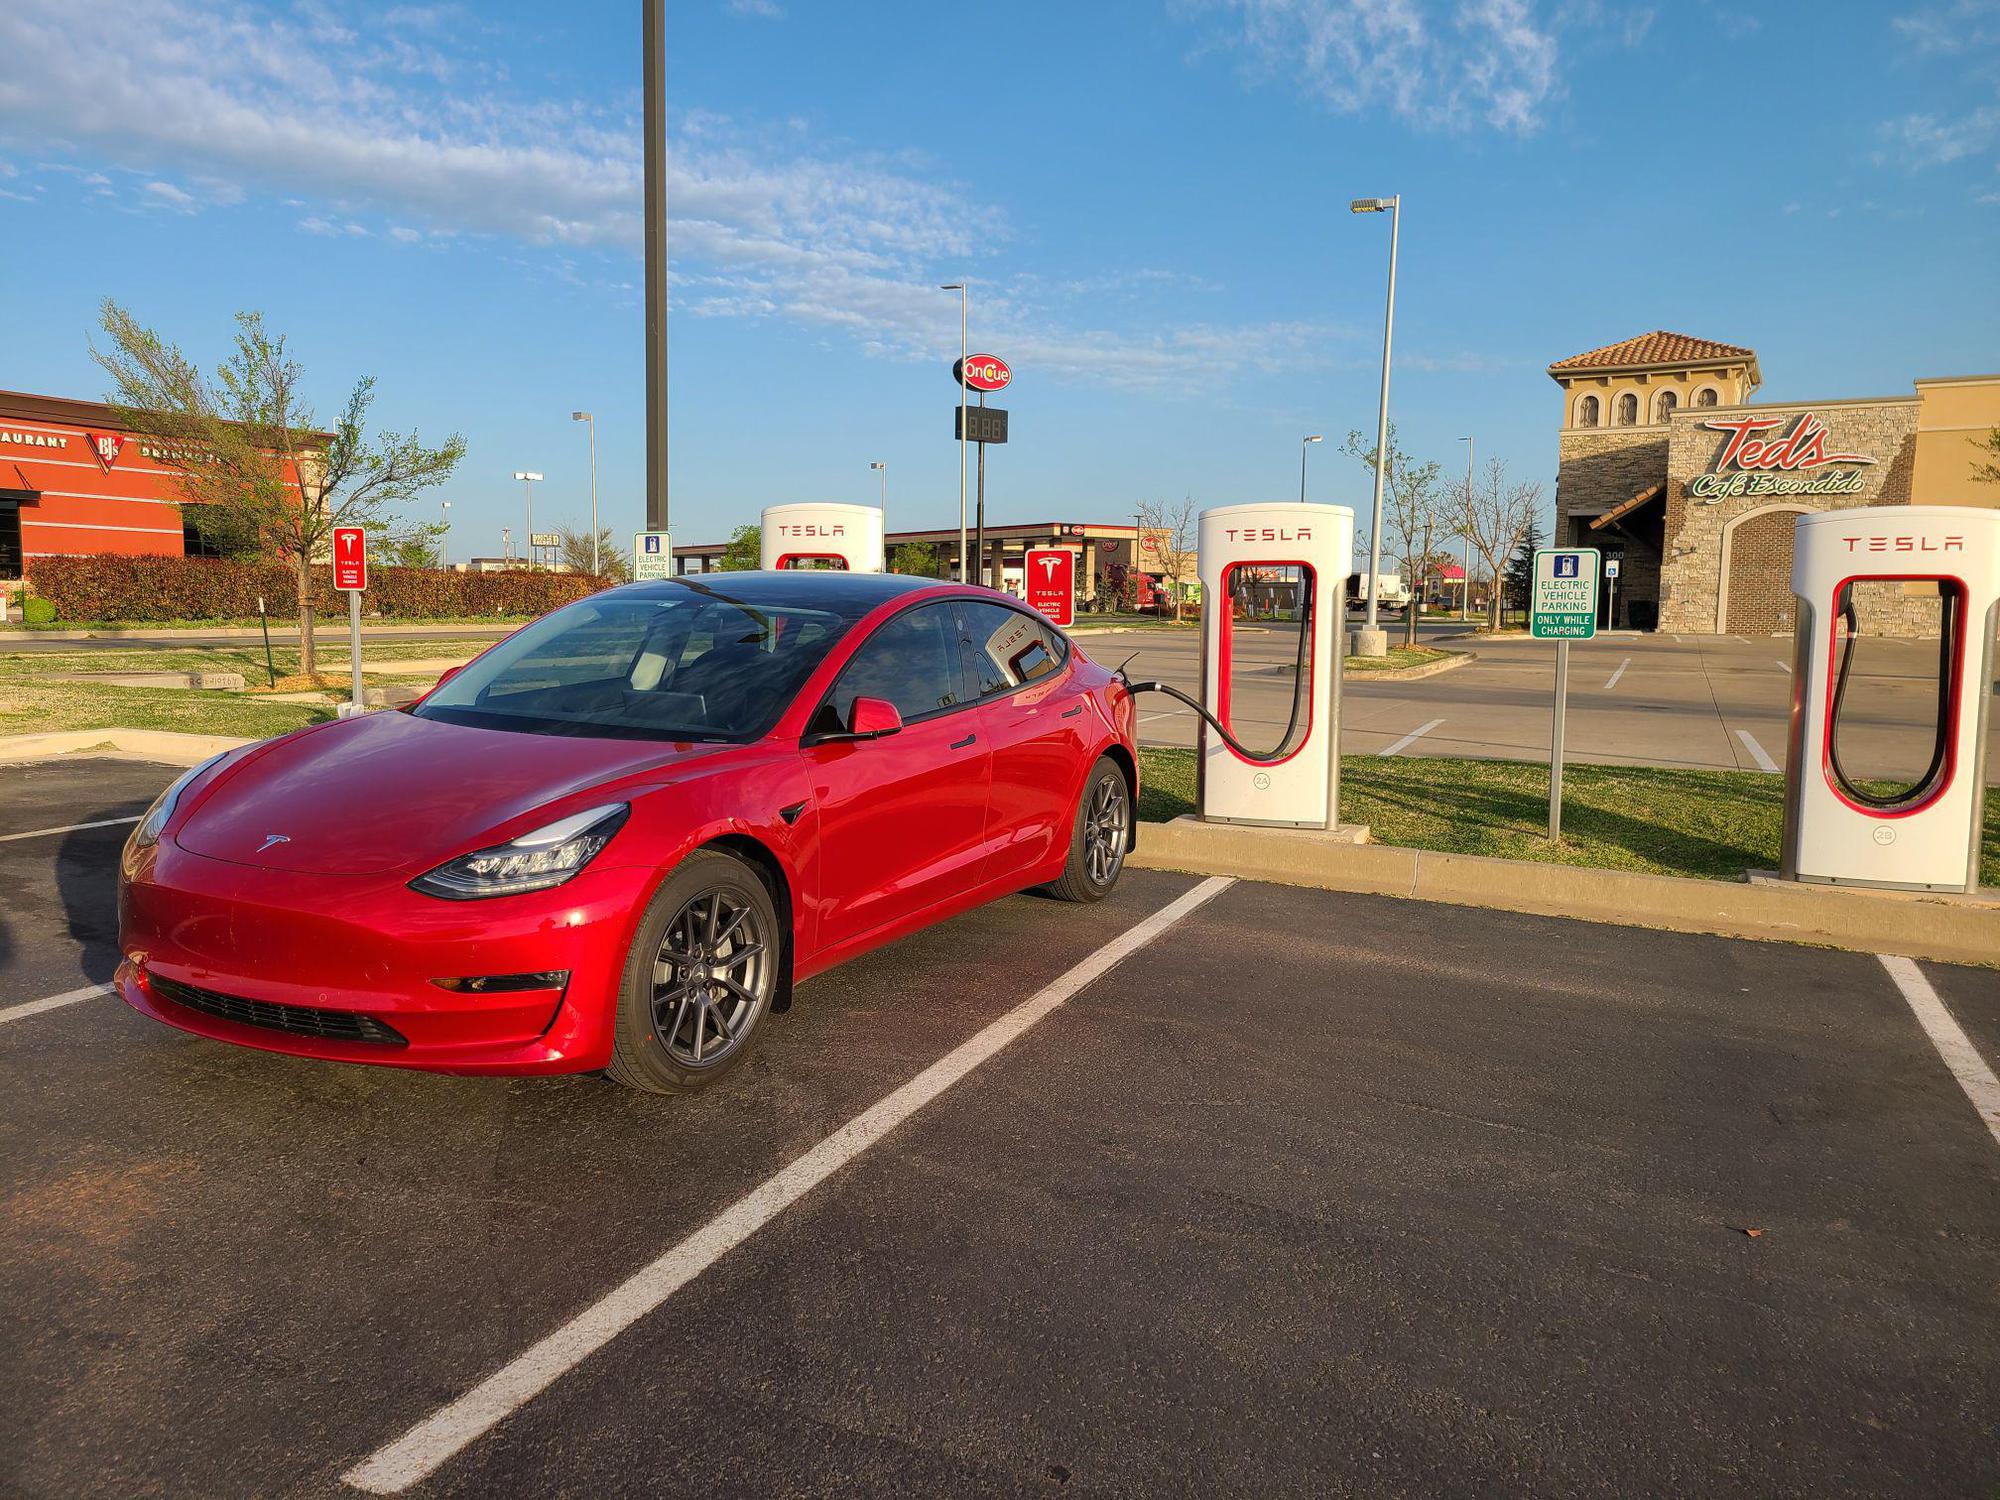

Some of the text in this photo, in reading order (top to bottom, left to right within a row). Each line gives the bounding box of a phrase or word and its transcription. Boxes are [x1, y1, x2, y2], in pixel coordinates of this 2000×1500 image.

[965, 363, 1009, 383] OnCue
[1, 432, 67, 449] AURANT
[1705, 412, 1878, 473] Ted's
[98, 437, 119, 461] BJ's
[1693, 469, 1866, 504] Café Escondido
[779, 525, 845, 537] TESLA
[1226, 528, 1312, 542] TESLA
[1842, 536, 1963, 552] TESLA
[638, 555, 667, 563] ELECTRIC
[1606, 551, 1624, 560] 300
[639, 572, 667, 580] PARKING
[1541, 580, 1590, 590] ELECTRIC
[1543, 591, 1587, 600] VEHICLE
[1541, 602, 1587, 611] PARKING
[1537, 615, 1590, 625] ONLY WHILE
[1541, 626, 1585, 635] CHARGING
[1256, 777, 1269, 785] 2A
